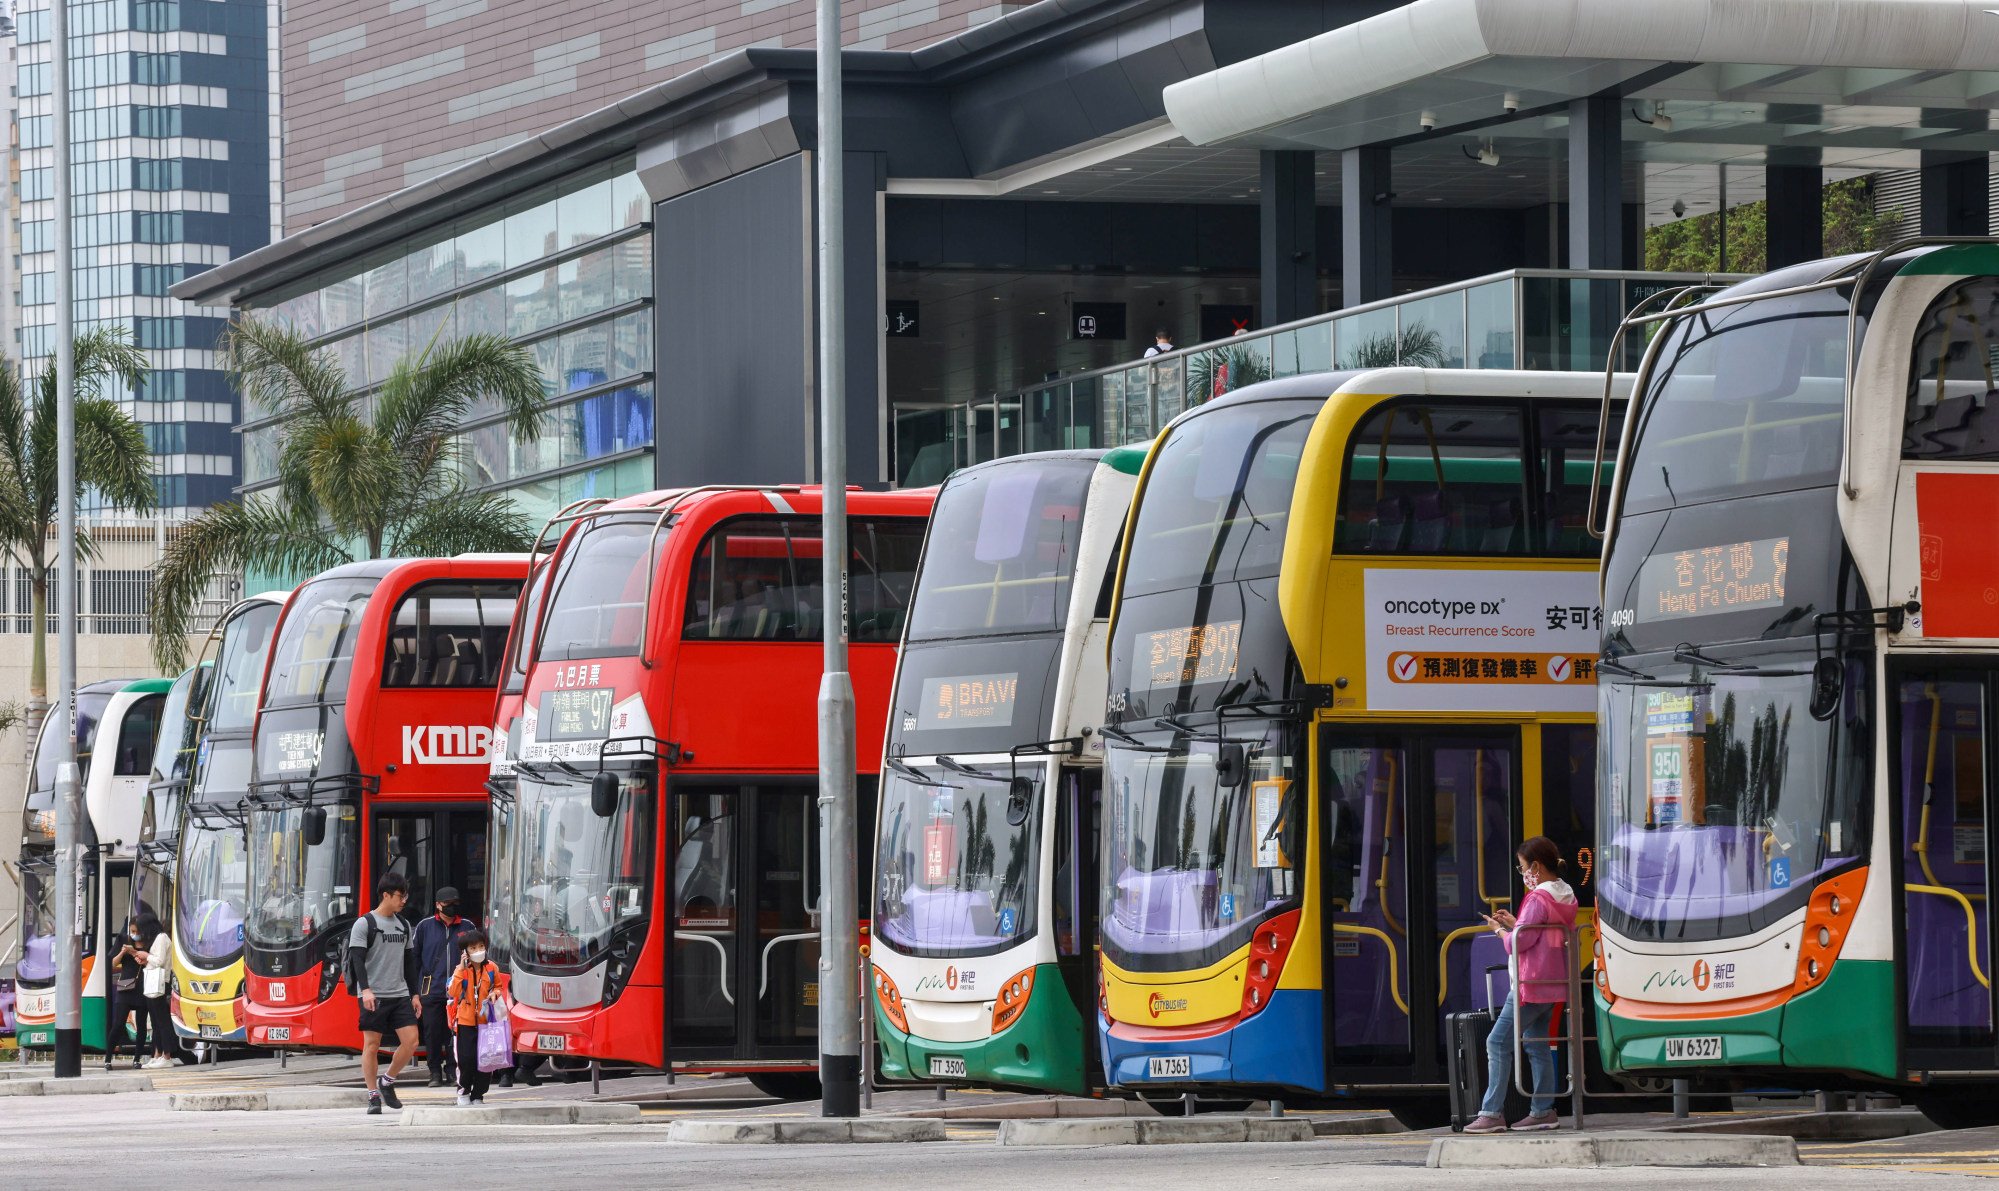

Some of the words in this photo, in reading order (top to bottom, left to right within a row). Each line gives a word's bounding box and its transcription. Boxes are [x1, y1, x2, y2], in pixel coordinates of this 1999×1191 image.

[1674, 541, 1753, 587] 杏花邨
[1659, 590, 1697, 613] Heng
[1700, 584, 1720, 608] Fa
[1724, 580, 1771, 604] Chuen
[1385, 598, 1476, 619] oncotype
[1611, 609, 1634, 626] 4090
[1386, 624, 1425, 636] Breast
[1428, 624, 1498, 637] Recurrence
[1501, 625, 1536, 637] Score
[554, 664, 602, 689] 九巴月票
[1423, 657, 1538, 679] 預測復發機率
[591, 689, 612, 731] 97
[1107, 693, 1126, 712] 6425
[903, 718, 917, 731] 5661
[403, 725, 492, 764] KMB
[1654, 751, 1680, 776] 950
[382, 933, 405, 943] PUMA
[960, 971, 976, 984] 新巴
[1714, 963, 1735, 979] 新巴
[268, 982, 287, 1001] KMB
[541, 981, 562, 1004] KMB
[1154, 999, 1177, 1010] CITYBUS
[276, 1028, 289, 1039] 8945
[549, 1036, 563, 1048] 9134
[1668, 1040, 1684, 1057] UW
[1687, 1038, 1718, 1056] 6327
[932, 1059, 943, 1073] TT
[945, 1059, 965, 1074] 3500
[1152, 1059, 1163, 1075] VA
[1165, 1059, 1188, 1075] 7363
